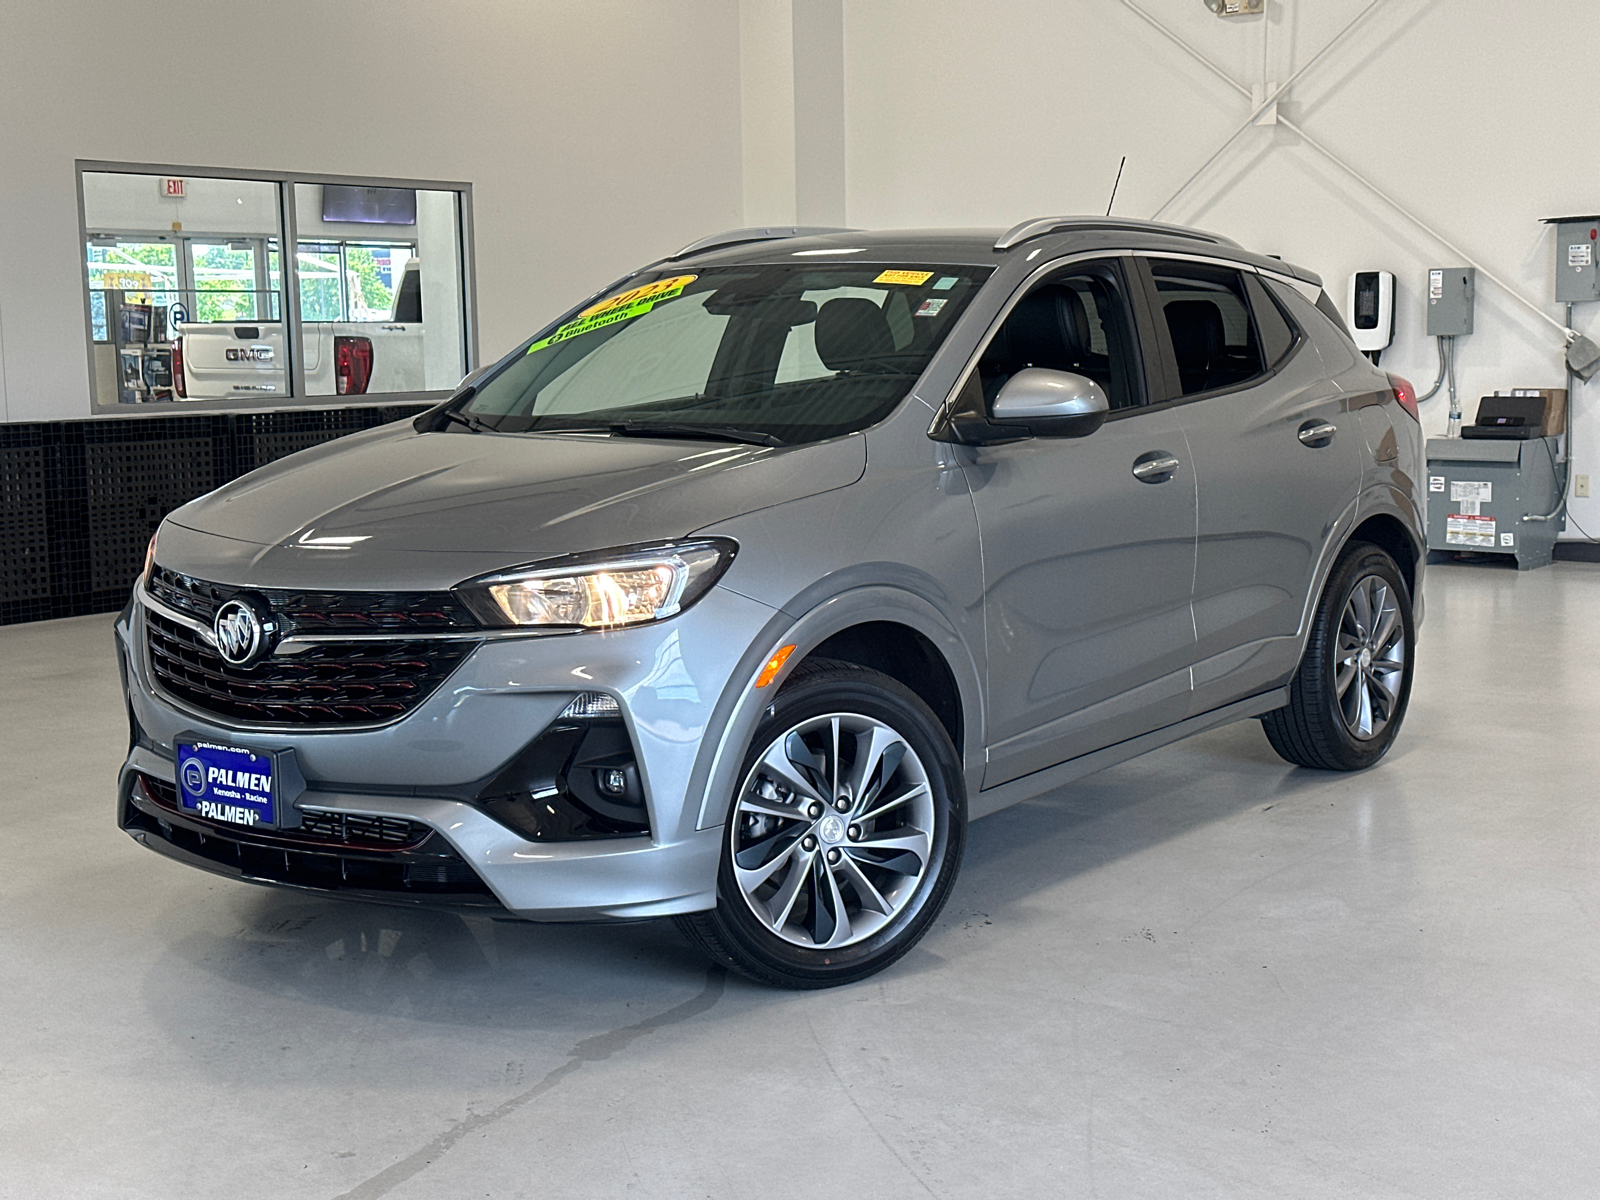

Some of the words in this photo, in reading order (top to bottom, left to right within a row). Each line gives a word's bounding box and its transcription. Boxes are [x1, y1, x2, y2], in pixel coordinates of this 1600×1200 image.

[167, 179, 183, 195] EXIT
[594, 279, 679, 311] 2023
[561, 318, 588, 332] ALL
[589, 301, 635, 322] WHEEL
[636, 286, 680, 307] DRIVE
[565, 312, 628, 337] Bluetooth
[225, 348, 273, 362] GMC
[197, 742, 250, 754] palmen.com
[208, 766, 272, 793] PALMEN
[213, 787, 241, 799] Kenosha
[245, 793, 268, 804] Racine
[201, 800, 254, 826] PALMEN
